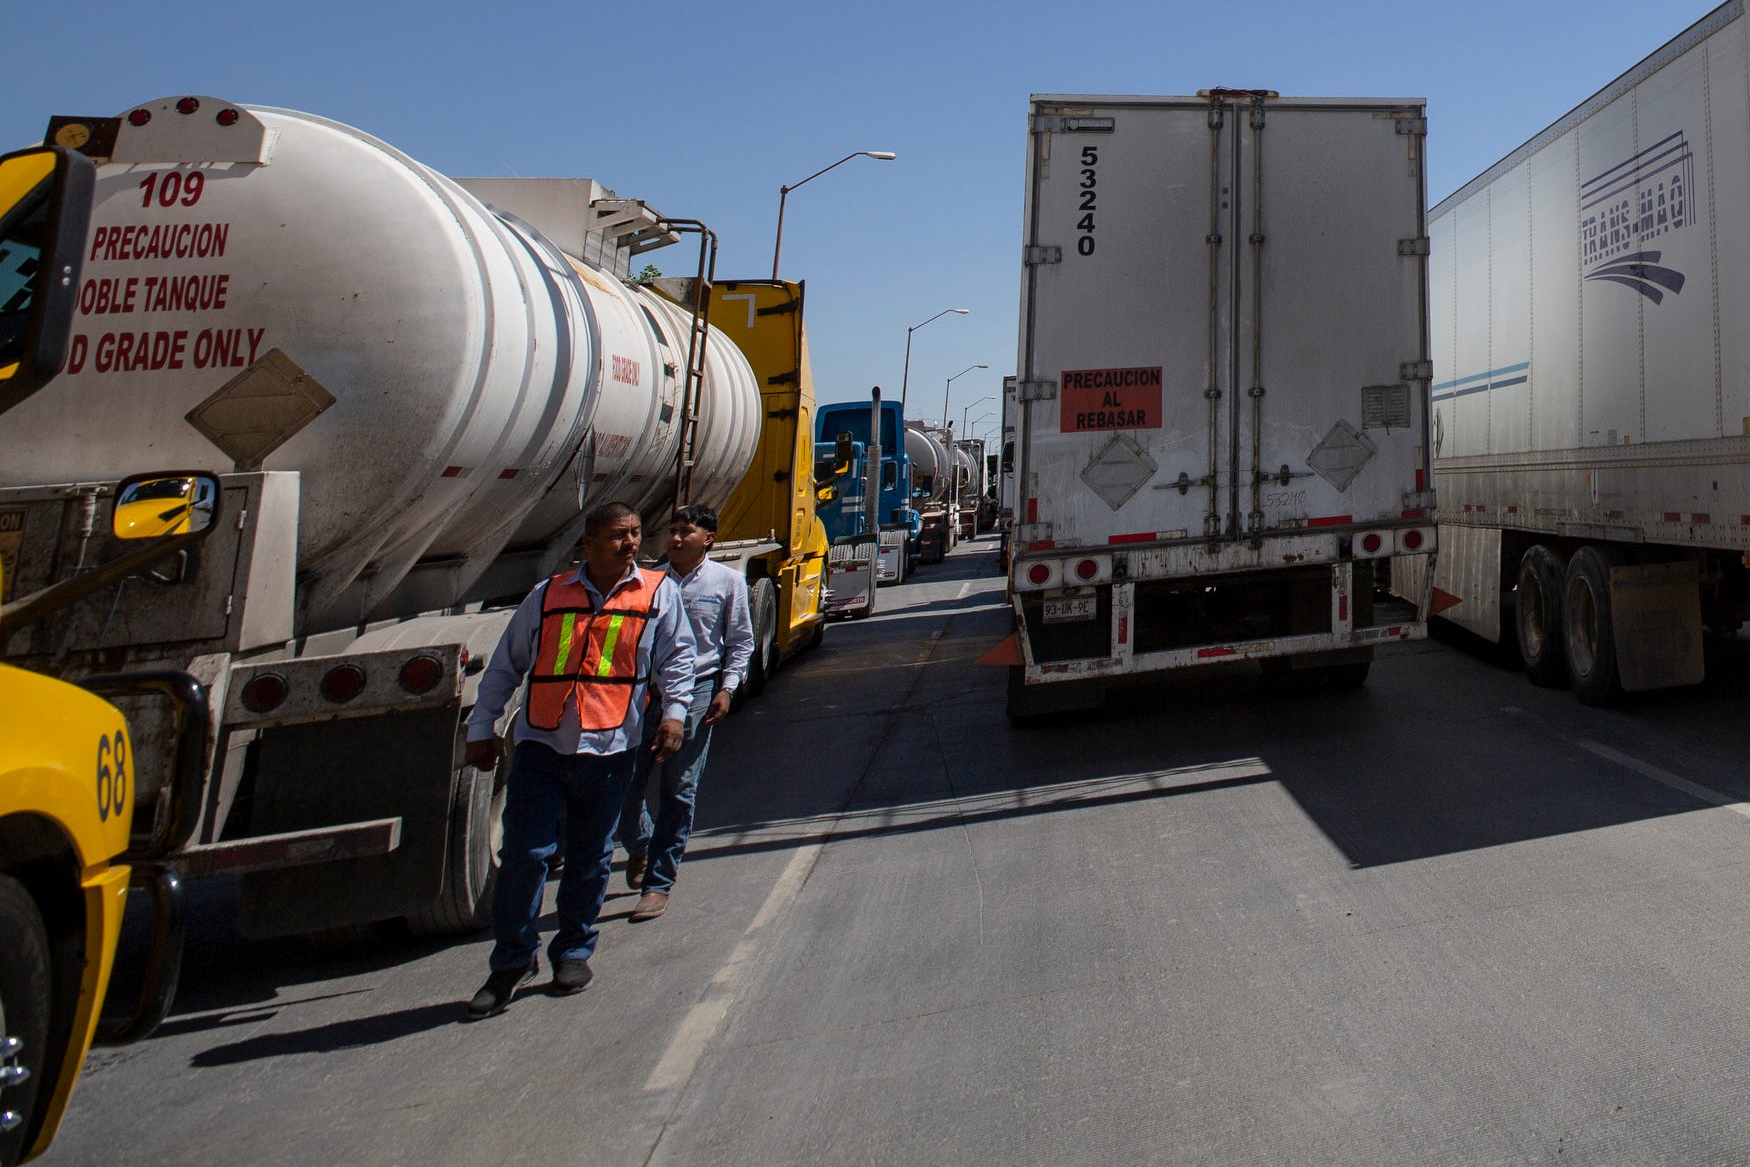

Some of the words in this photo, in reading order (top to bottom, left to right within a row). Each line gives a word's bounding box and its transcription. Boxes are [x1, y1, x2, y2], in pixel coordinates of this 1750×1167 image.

[138, 170, 206, 208] 109
[1077, 146, 1099, 256] 53240
[90, 223, 230, 261] PRECAUCION
[144, 274, 230, 314] TANQUE
[95, 330, 189, 373] GRADE
[193, 328, 266, 369] ONLY
[1063, 369, 1161, 390] PRECAUCION
[1102, 391, 1122, 408] AL
[1076, 410, 1146, 430] REBASAR
[97, 728, 127, 824] 68
